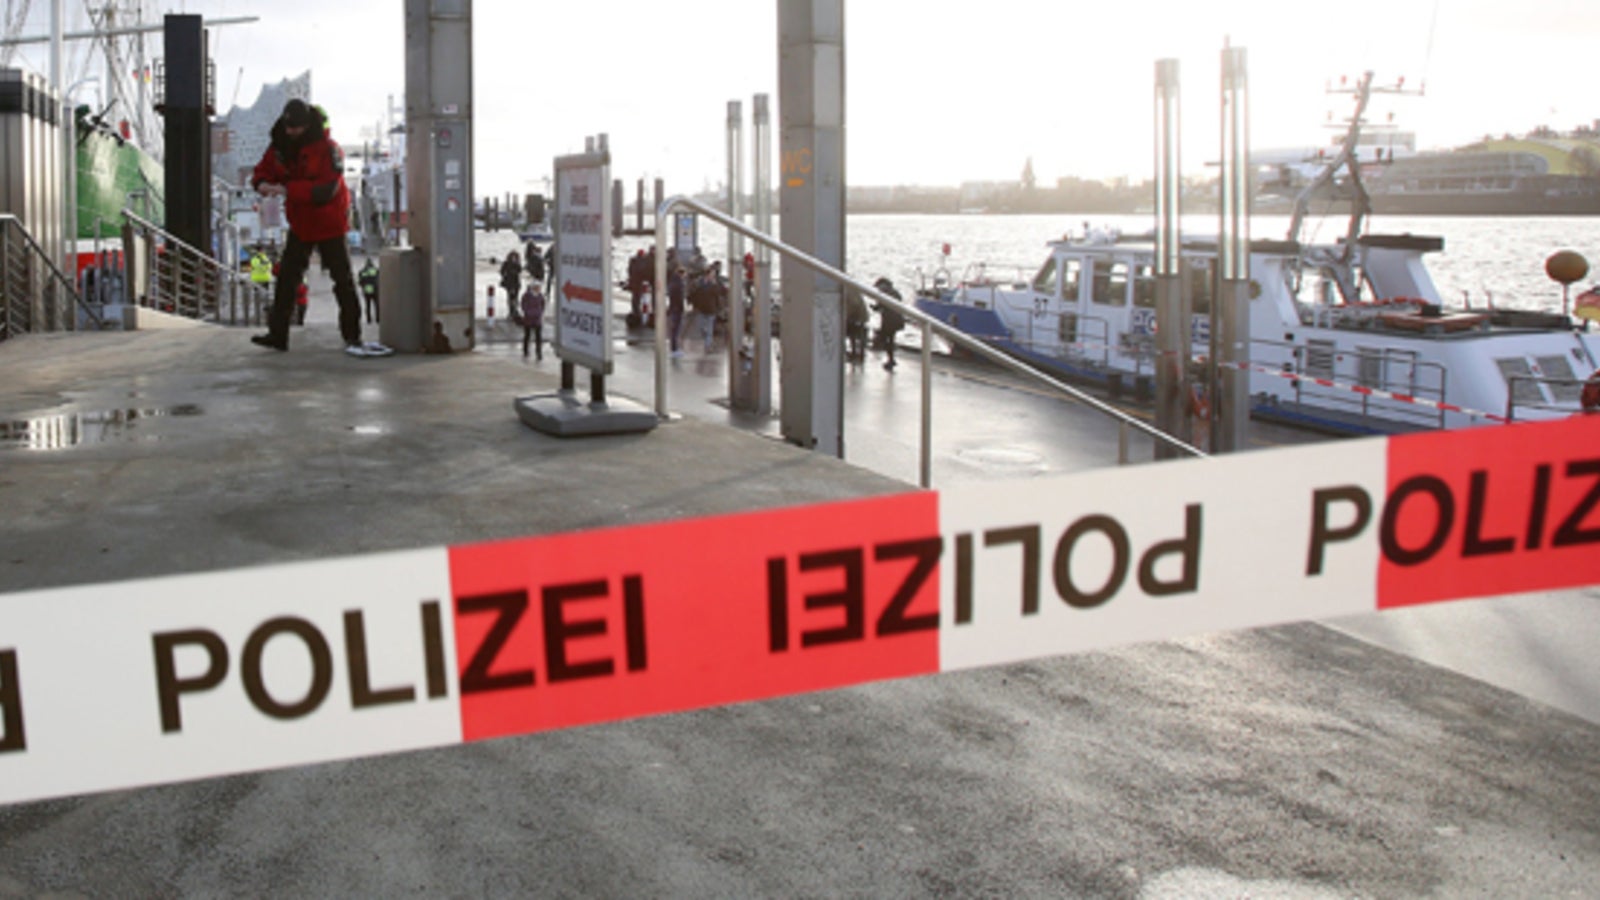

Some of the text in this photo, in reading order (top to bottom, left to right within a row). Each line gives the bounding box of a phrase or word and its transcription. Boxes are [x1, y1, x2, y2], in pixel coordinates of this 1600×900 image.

[781, 147, 813, 174] WC
[561, 307, 604, 337] TICKETS
[766, 503, 1203, 653] POLIZEI
[151, 574, 648, 734] POLIZEI
